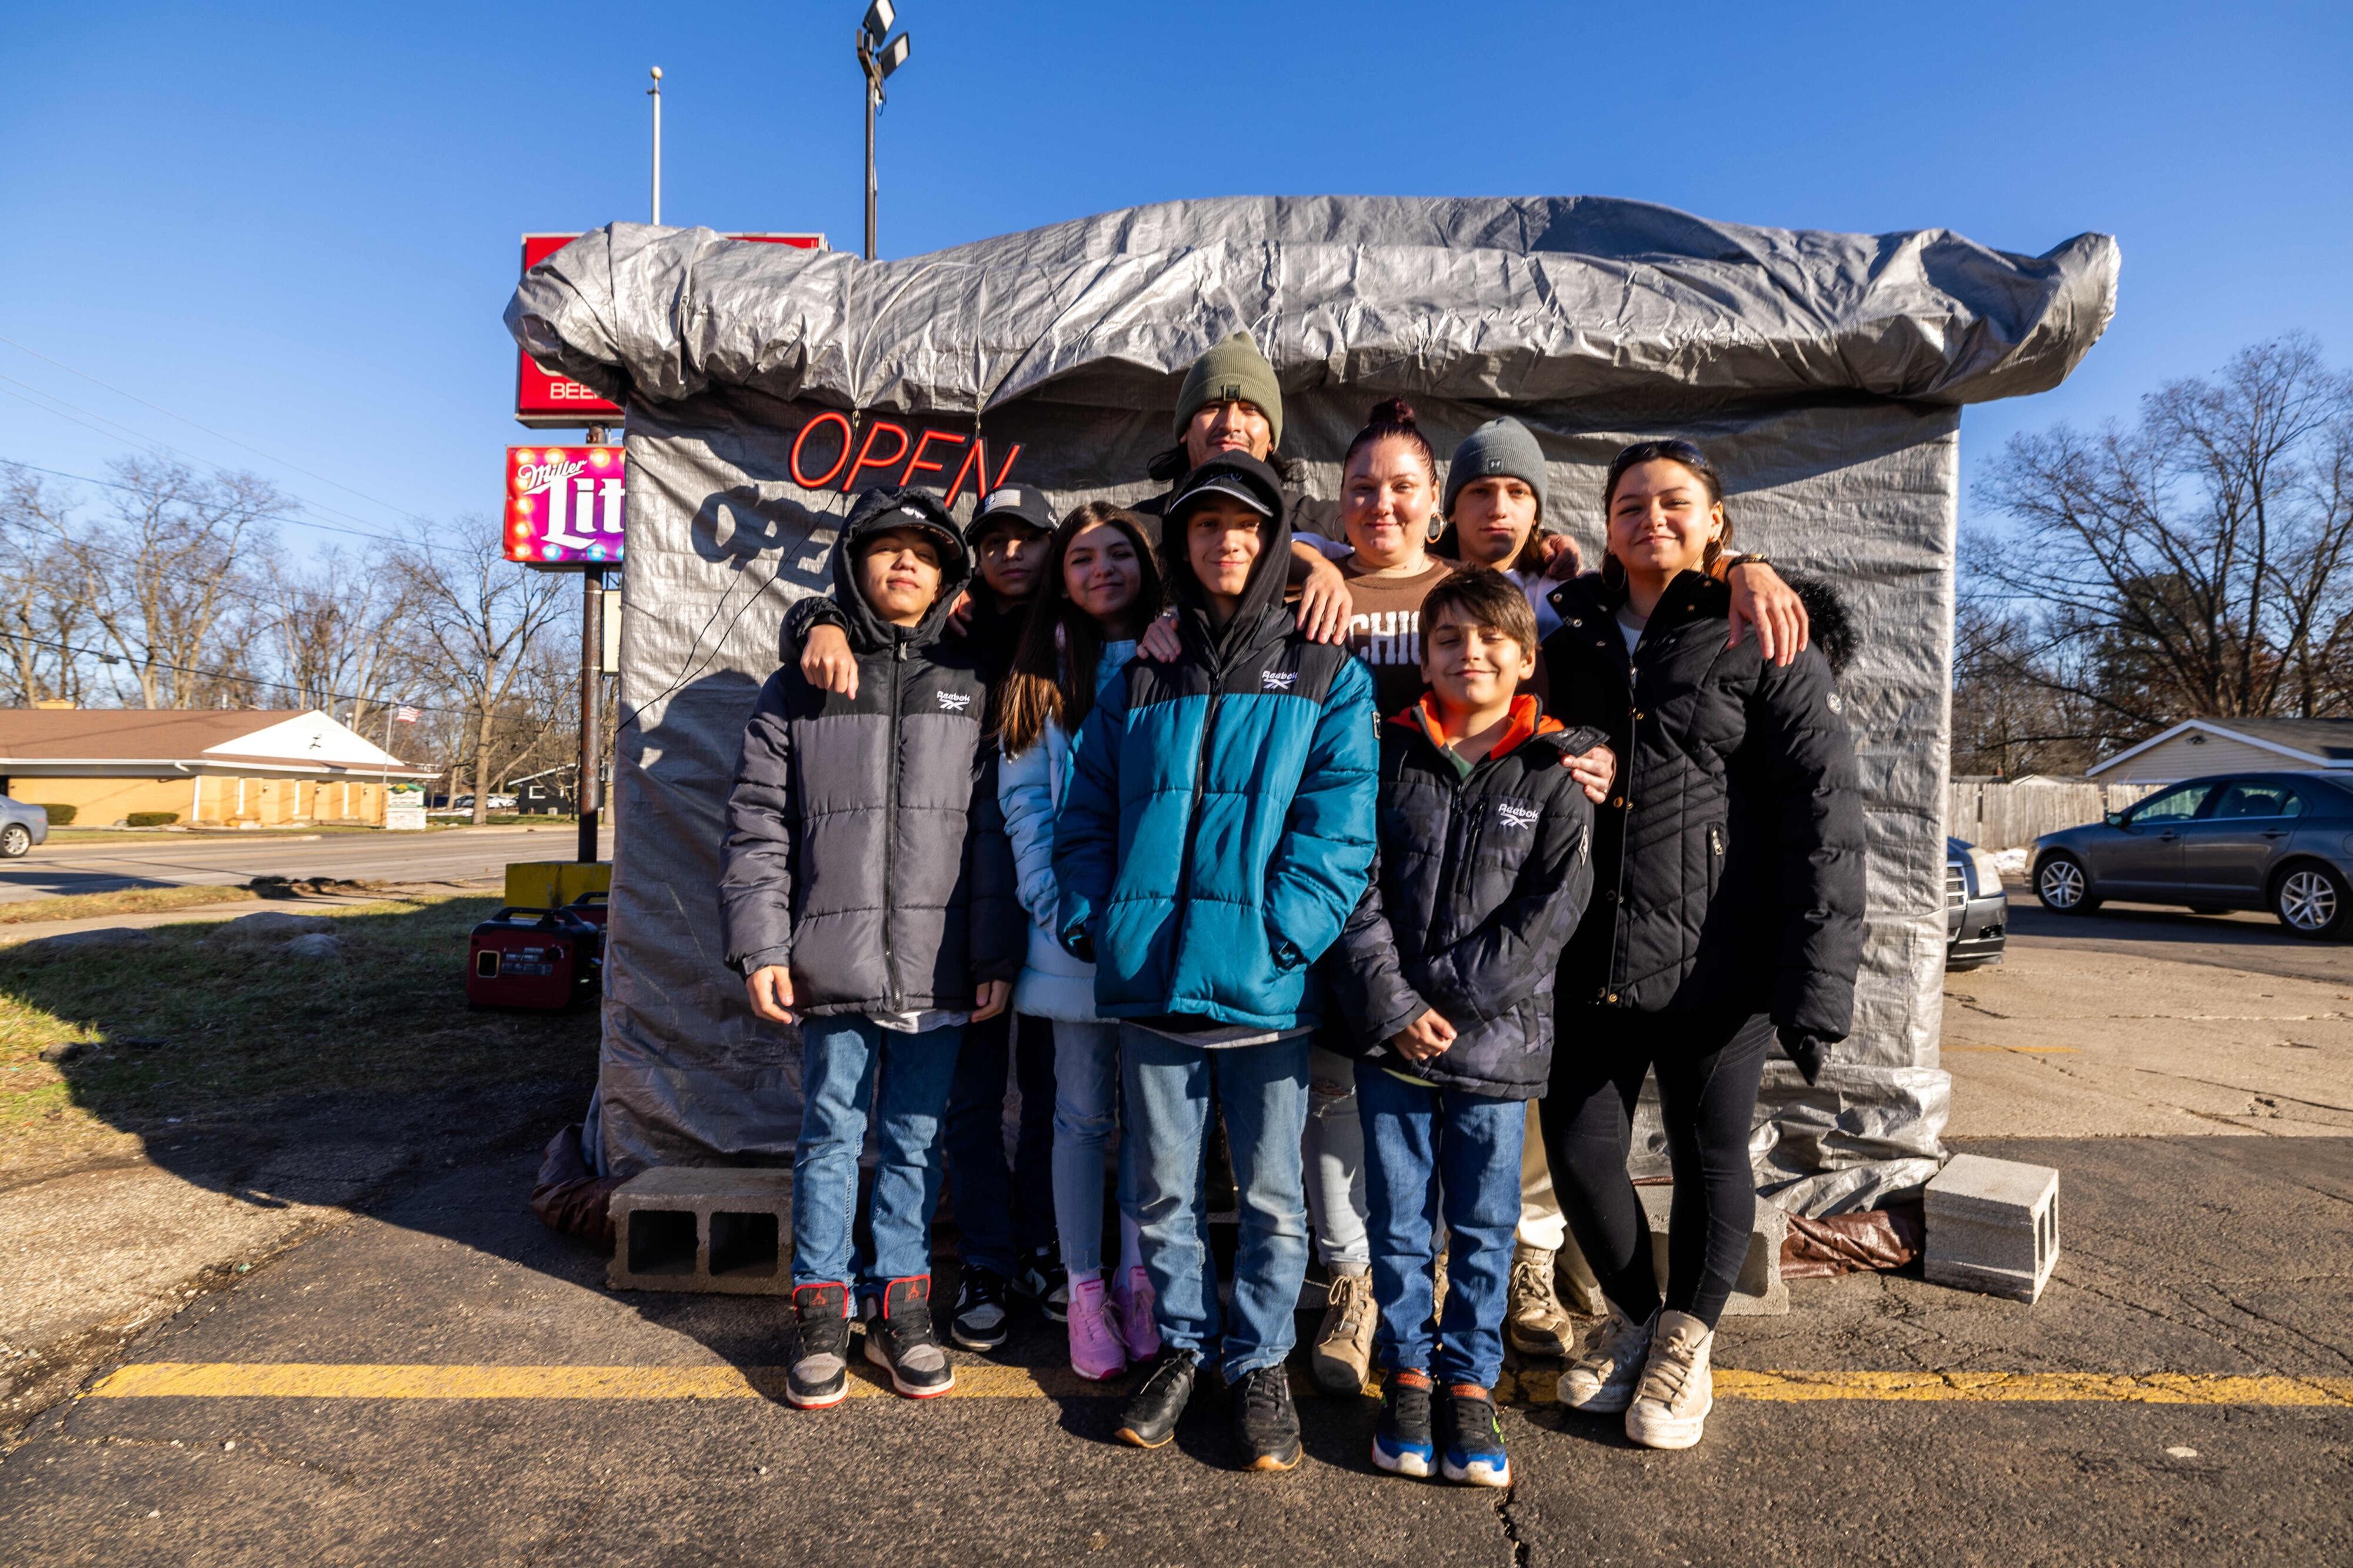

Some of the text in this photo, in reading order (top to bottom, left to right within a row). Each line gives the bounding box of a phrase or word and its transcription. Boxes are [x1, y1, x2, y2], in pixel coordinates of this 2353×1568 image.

[550, 382, 598, 399] BEE
[518, 459, 588, 494] Miller
[1262, 670, 1298, 680] Reebok
[936, 690, 970, 702] Reebok
[1498, 803, 1539, 819] Reebok
